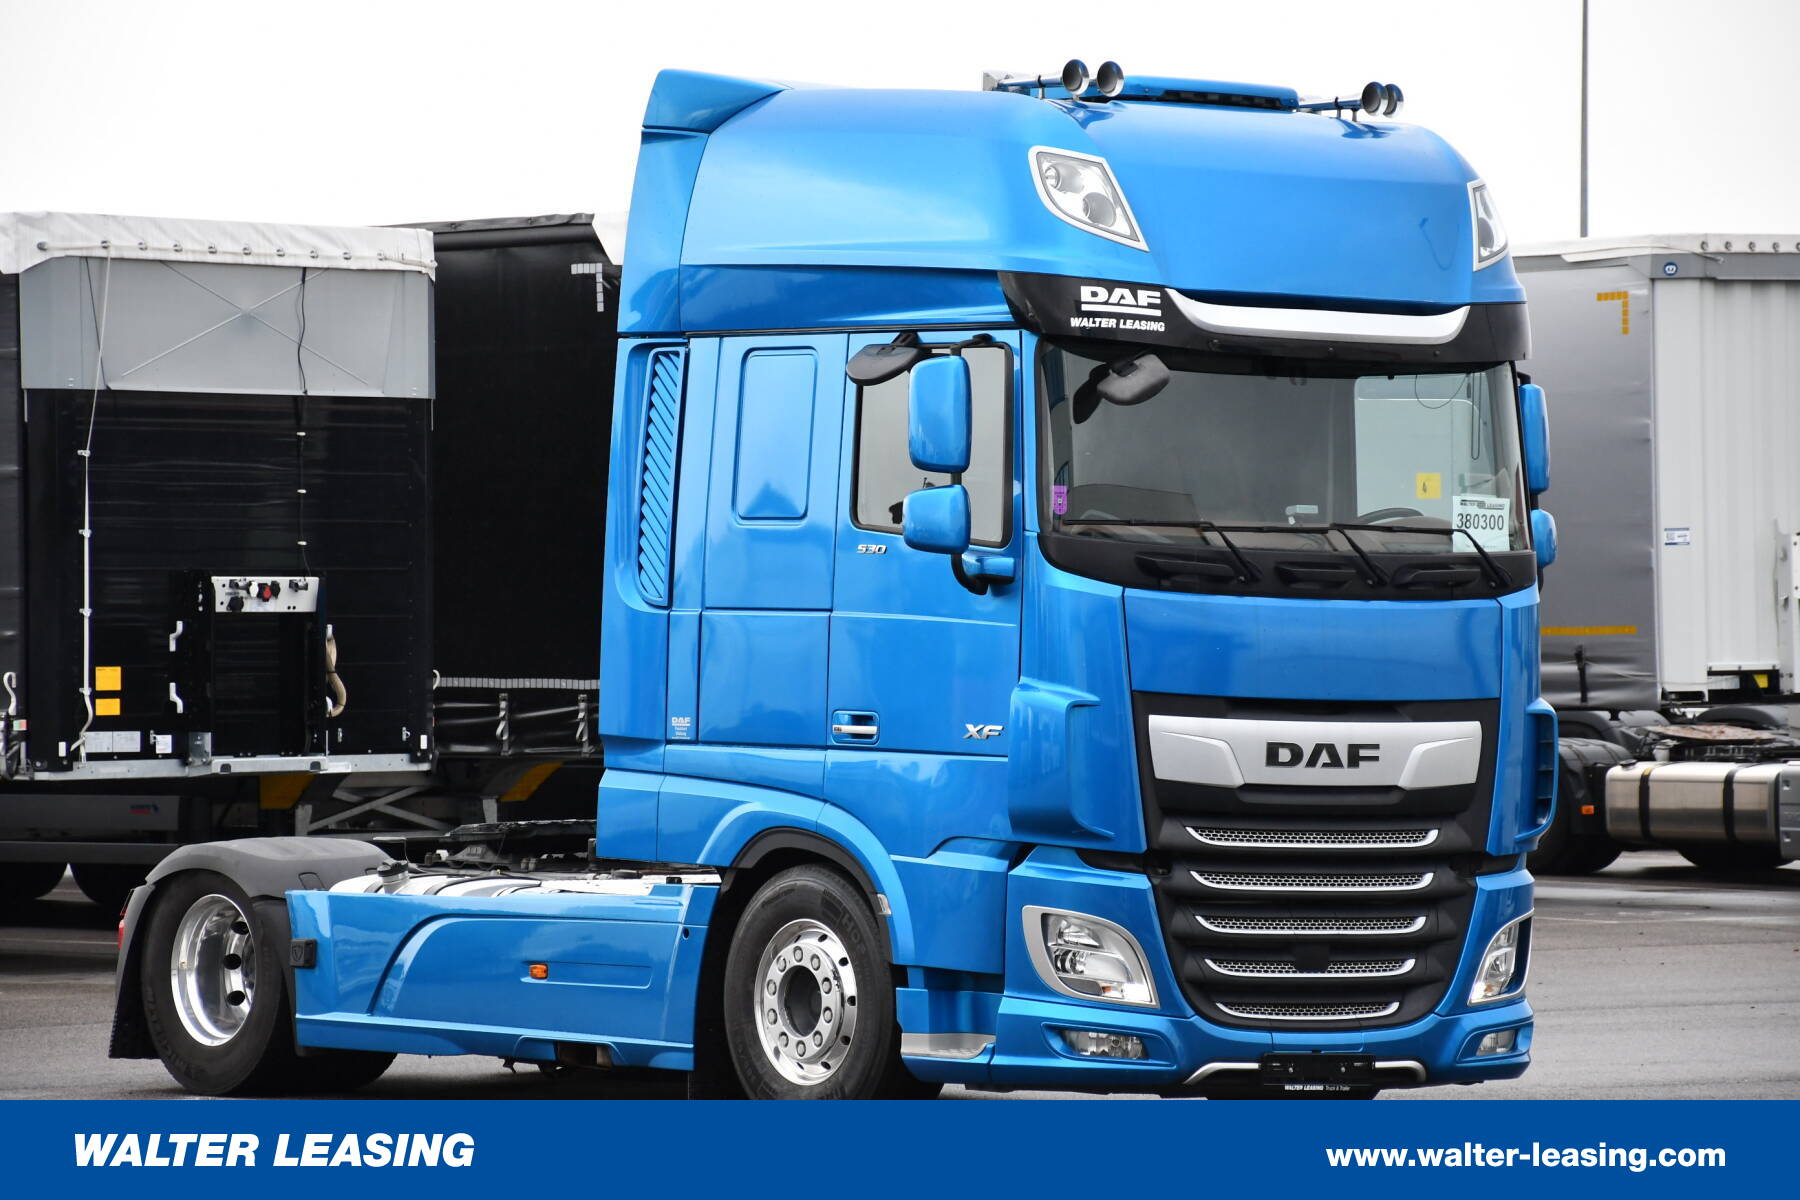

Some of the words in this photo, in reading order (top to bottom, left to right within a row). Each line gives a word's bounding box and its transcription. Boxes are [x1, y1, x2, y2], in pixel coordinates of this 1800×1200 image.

[1080, 285, 1161, 307] DAF
[1070, 317, 1117, 329] WALTER
[1119, 319, 1166, 332] LEASING
[1456, 512, 1505, 531] 380300
[856, 544, 887, 554] 530
[962, 724, 1004, 740] XF
[1265, 741, 1381, 769] DAF
